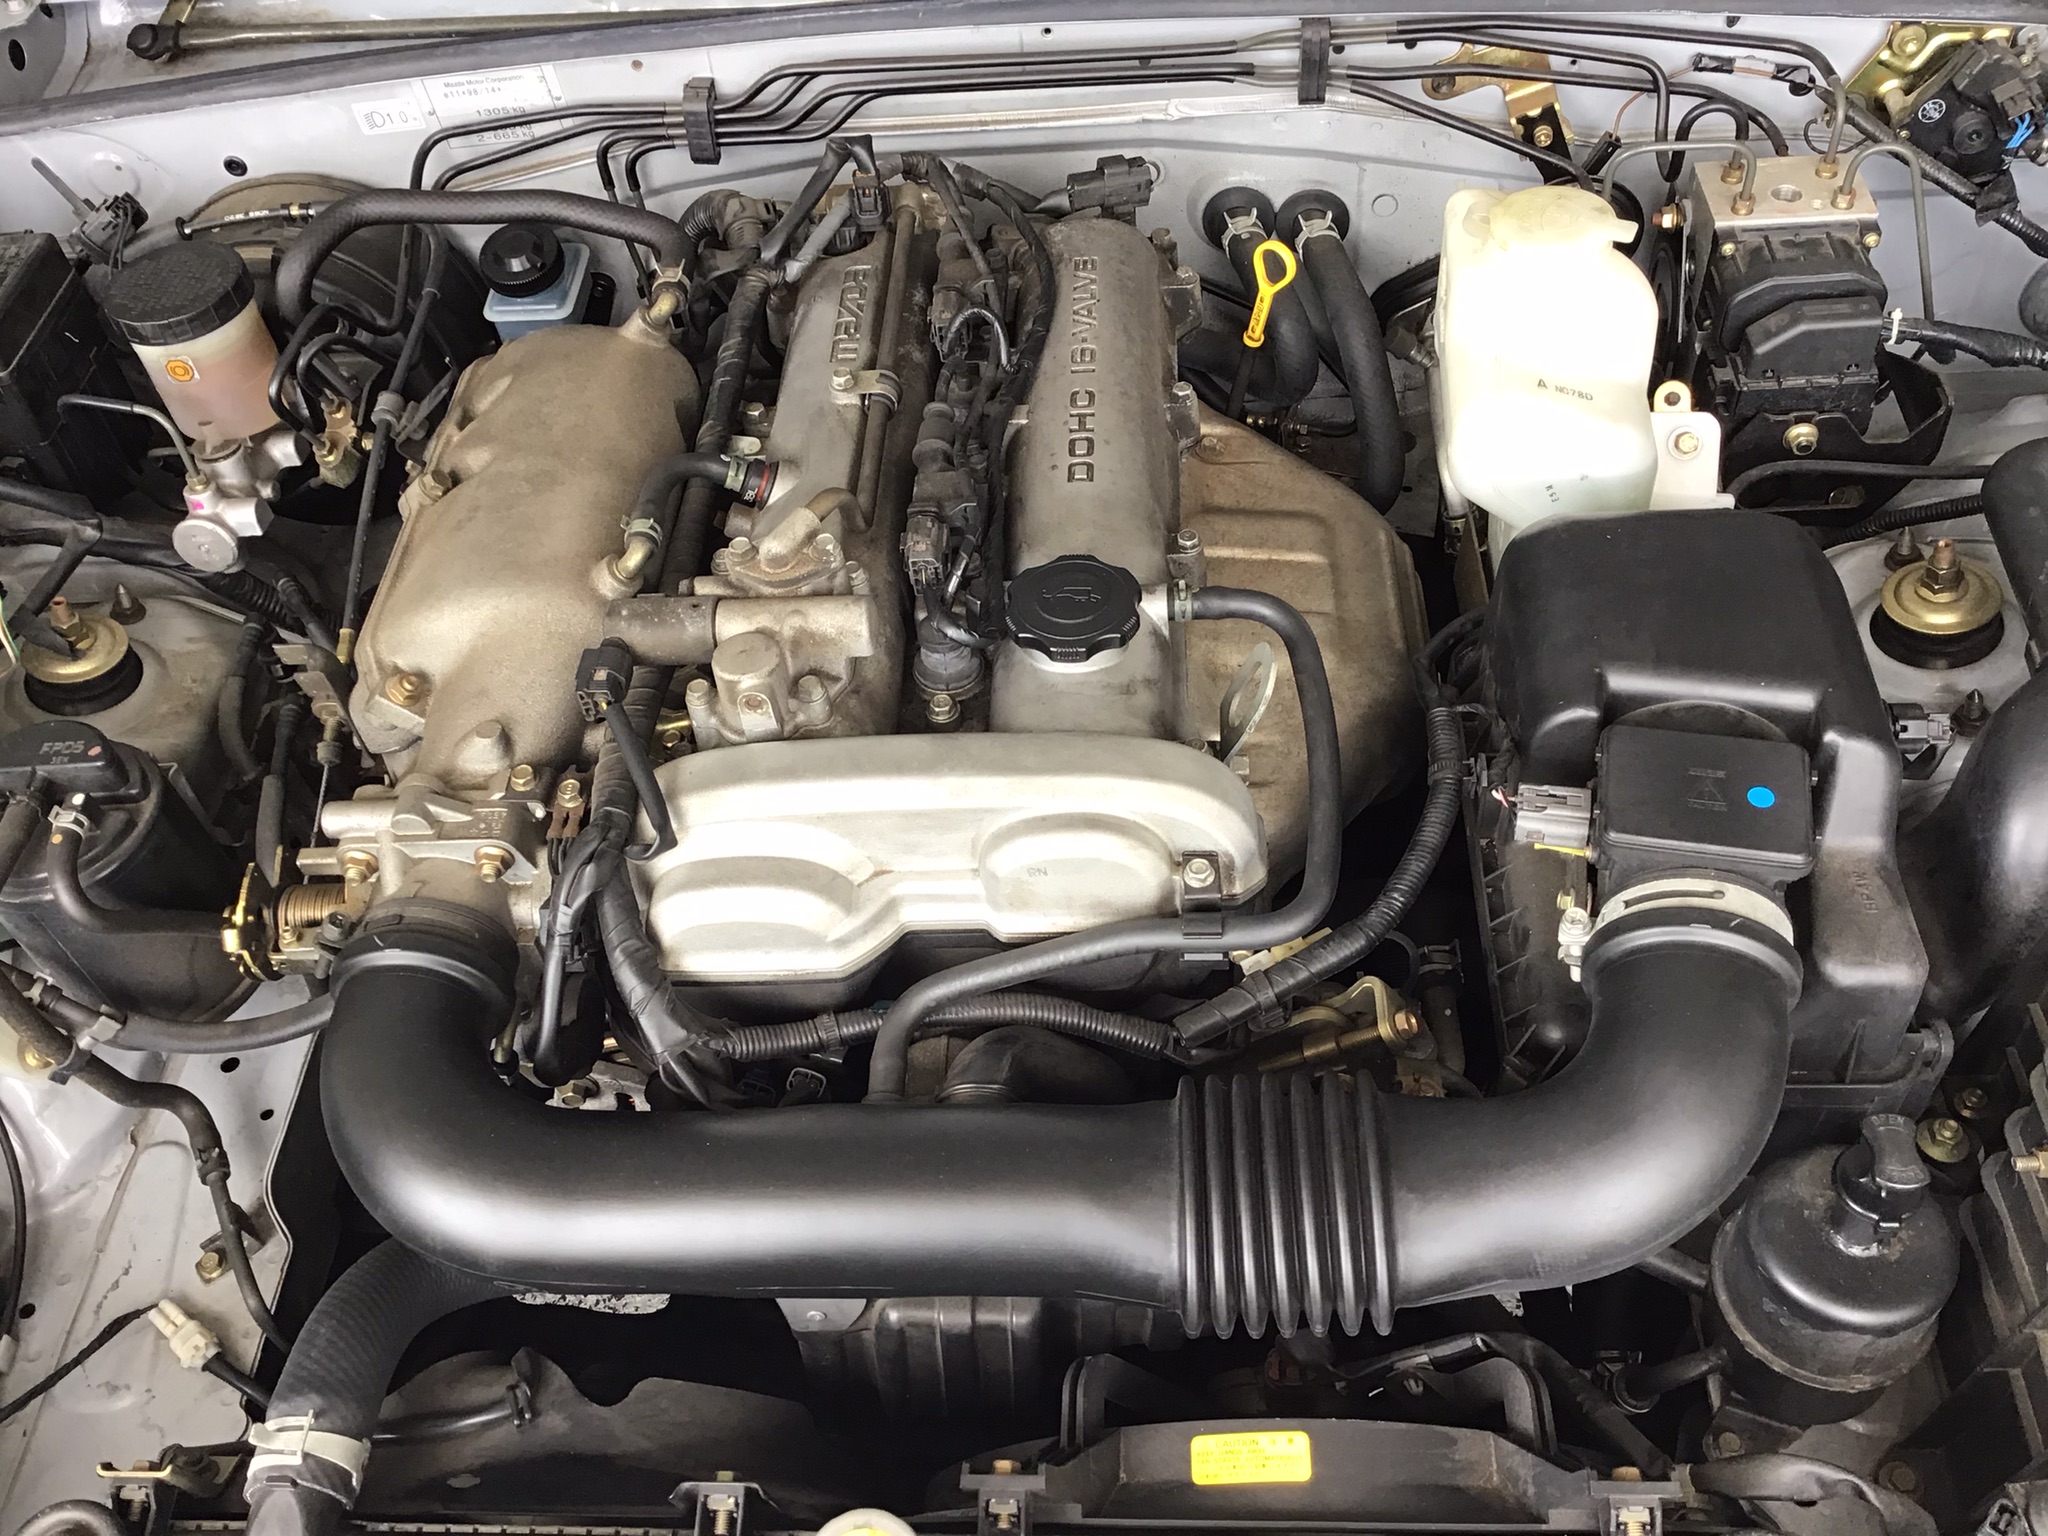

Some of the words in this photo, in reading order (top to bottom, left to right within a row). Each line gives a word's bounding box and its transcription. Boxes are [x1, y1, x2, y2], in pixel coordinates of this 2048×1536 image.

[443, 81, 466, 89] Mazda
[466, 78, 485, 86] Motor
[485, 74, 525, 85] Corporation
[476, 106, 510, 117] 1305
[512, 105, 527, 115] kg
[1069, 256, 1099, 374] 16-VALVE
[1537, 378, 1548, 390] A
[1067, 388, 1097, 483] DOHC
[1871, 1113, 1905, 1126] OPEN
[1215, 1438, 1259, 1449] CAUTION
